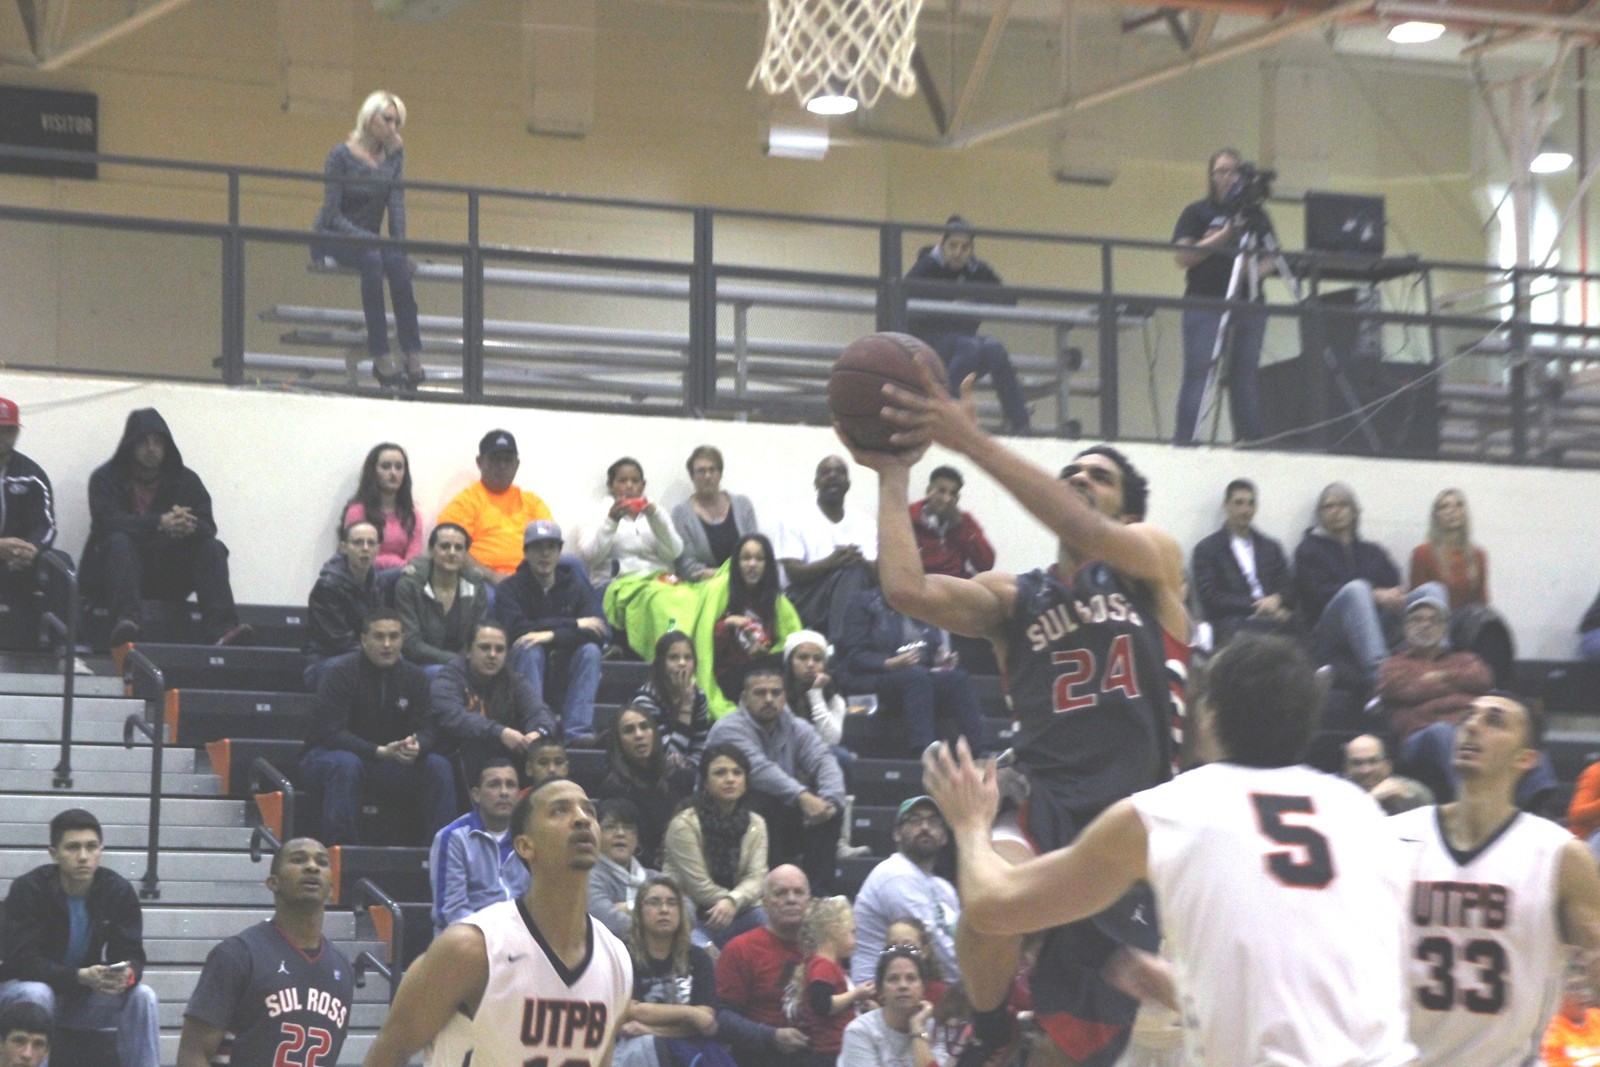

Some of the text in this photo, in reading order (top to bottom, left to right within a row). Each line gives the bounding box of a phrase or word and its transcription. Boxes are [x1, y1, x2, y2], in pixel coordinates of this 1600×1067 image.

[40, 112, 94, 136] VISITOR
[1026, 603, 1079, 651] SUL
[1052, 634, 1142, 714] 24
[1248, 791, 1337, 891] 5
[1411, 879, 1509, 930] UTPB
[1413, 936, 1508, 1015] 33
[265, 987, 347, 1029] SUL ROSS
[520, 997, 607, 1049] UTPB
[272, 1022, 332, 1067] 22
